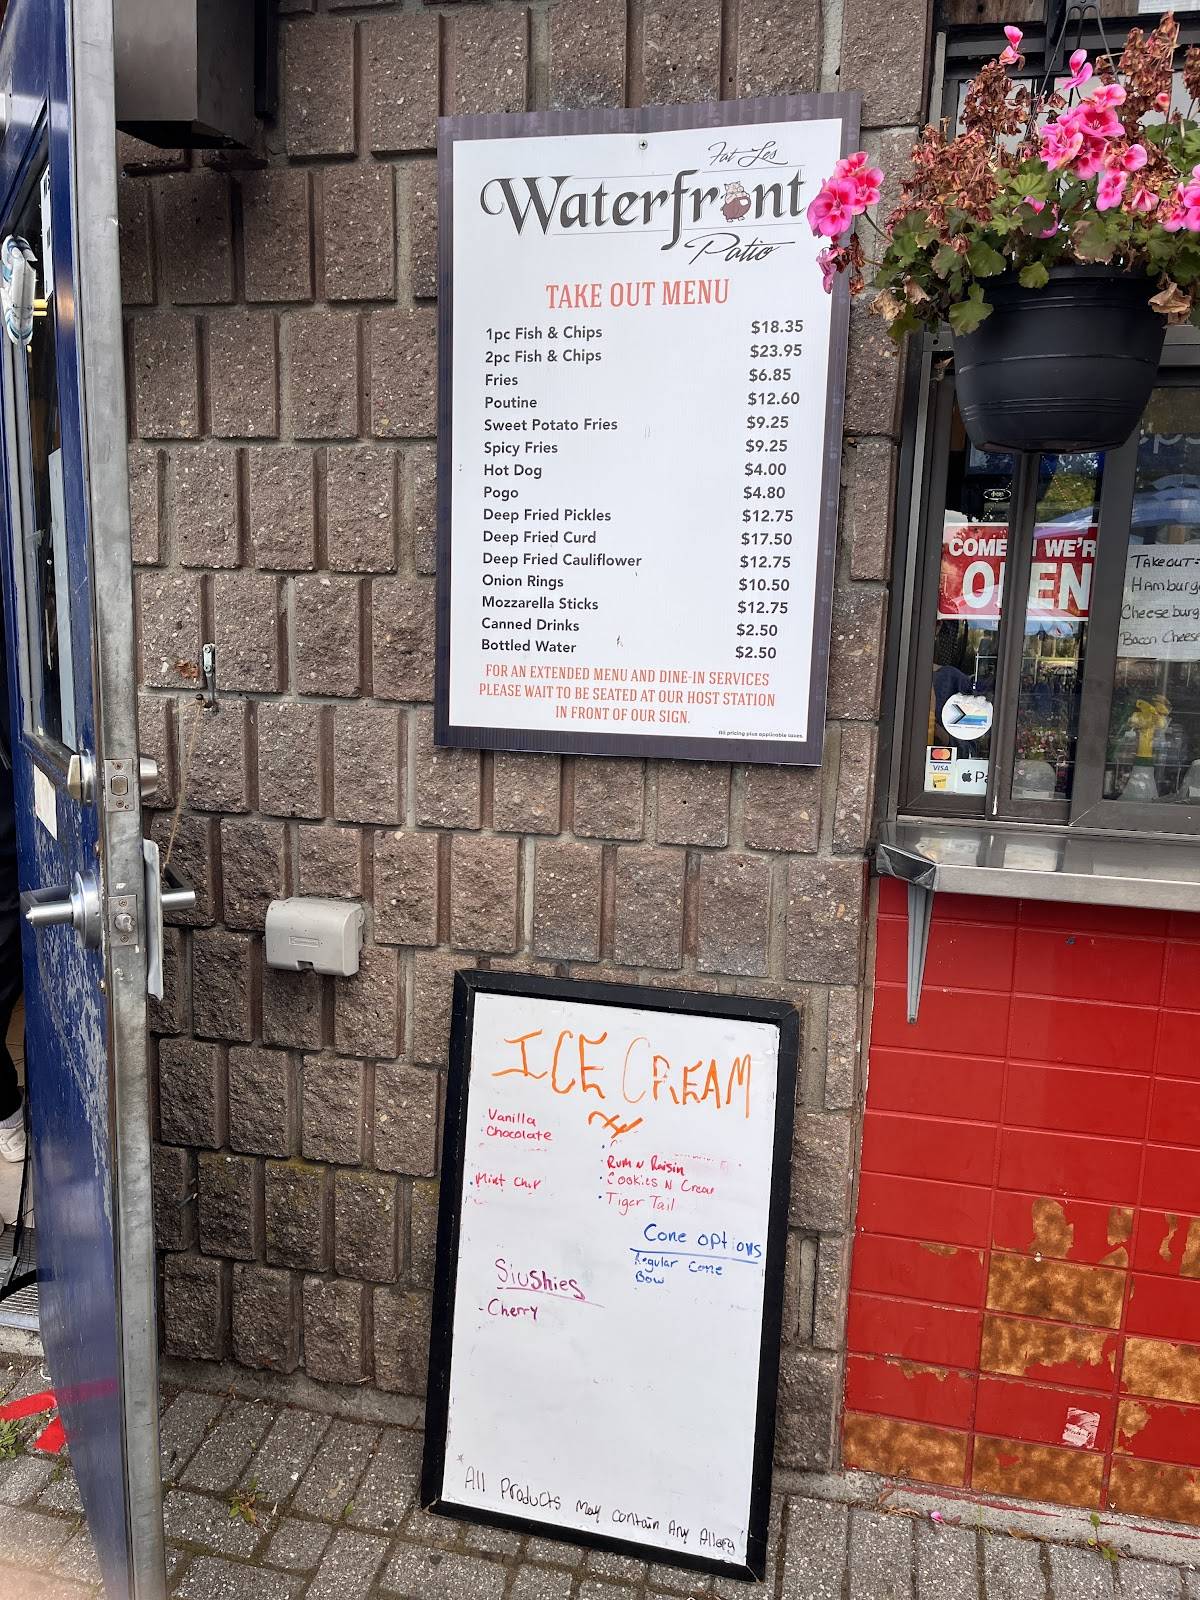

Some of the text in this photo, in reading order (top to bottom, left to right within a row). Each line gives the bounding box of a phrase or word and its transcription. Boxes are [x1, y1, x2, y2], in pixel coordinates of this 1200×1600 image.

[684, 232, 796, 265] Patio
[546, 278, 729, 309] TAKE OUT MENU
[486, 320, 804, 343] 1pc Fish & Chips $18.35
[485, 344, 802, 366] 2pc Fish & Chips $23.95
[485, 368, 791, 386] Fries $6.85
[485, 392, 800, 408] Poutine $12.60
[484, 416, 789, 431] Sweet Potato Fries $9.25
[484, 439, 788, 456] Spicy Fries $9.25
[484, 463, 787, 479] Hot Dog $4.00
[484, 486, 785, 501] Pogo $4.80
[483, 508, 793, 523] Deep Fried Pickles $12.75
[483, 531, 792, 546] Deep Fried Curd $17.50
[949, 538, 1008, 557] COME
[1044, 537, 1097, 558] WE'R
[483, 553, 791, 568] Deep Fried Cauliflower $12.75
[482, 574, 790, 591] Onion Rings $10.50
[963, 561, 1093, 611] OEN
[482, 596, 788, 614] Mozzarella Sticks $12.75
[482, 618, 778, 637] Canned Drinks $2.50
[1120, 631, 1157, 646] Bacon
[481, 639, 777, 659] Bottled Water $2.50
[486, 664, 770, 686] FOR AN EXTENDED MENU AND DINE-IN SERVICES
[479, 683, 775, 707] PLEASE WAIT TO BE SEATED AT OUR HOST STATION
[556, 705, 690, 724] IN FRONT OF OUR SIGN.
[727, 730, 745, 738] pricing
[491, 1028, 751, 1119] ICE CREAM
[488, 1108, 536, 1127] Vanilla
[486, 1125, 552, 1141] Chocolate
[607, 1155, 632, 1169] Rum
[650, 1155, 685, 1177] Raisin
[607, 1171, 658, 1188] Cookies
[664, 1180, 673, 1190] N
[606, 1192, 676, 1216] Tiger Tail
[643, 1223, 687, 1243] Cone
[688, 1260, 723, 1276] Cone
[487, 1298, 538, 1321] Cherry
[464, 1466, 486, 1492] All
[500, 1477, 561, 1510] Products
[668, 1519, 690, 1544] Any
